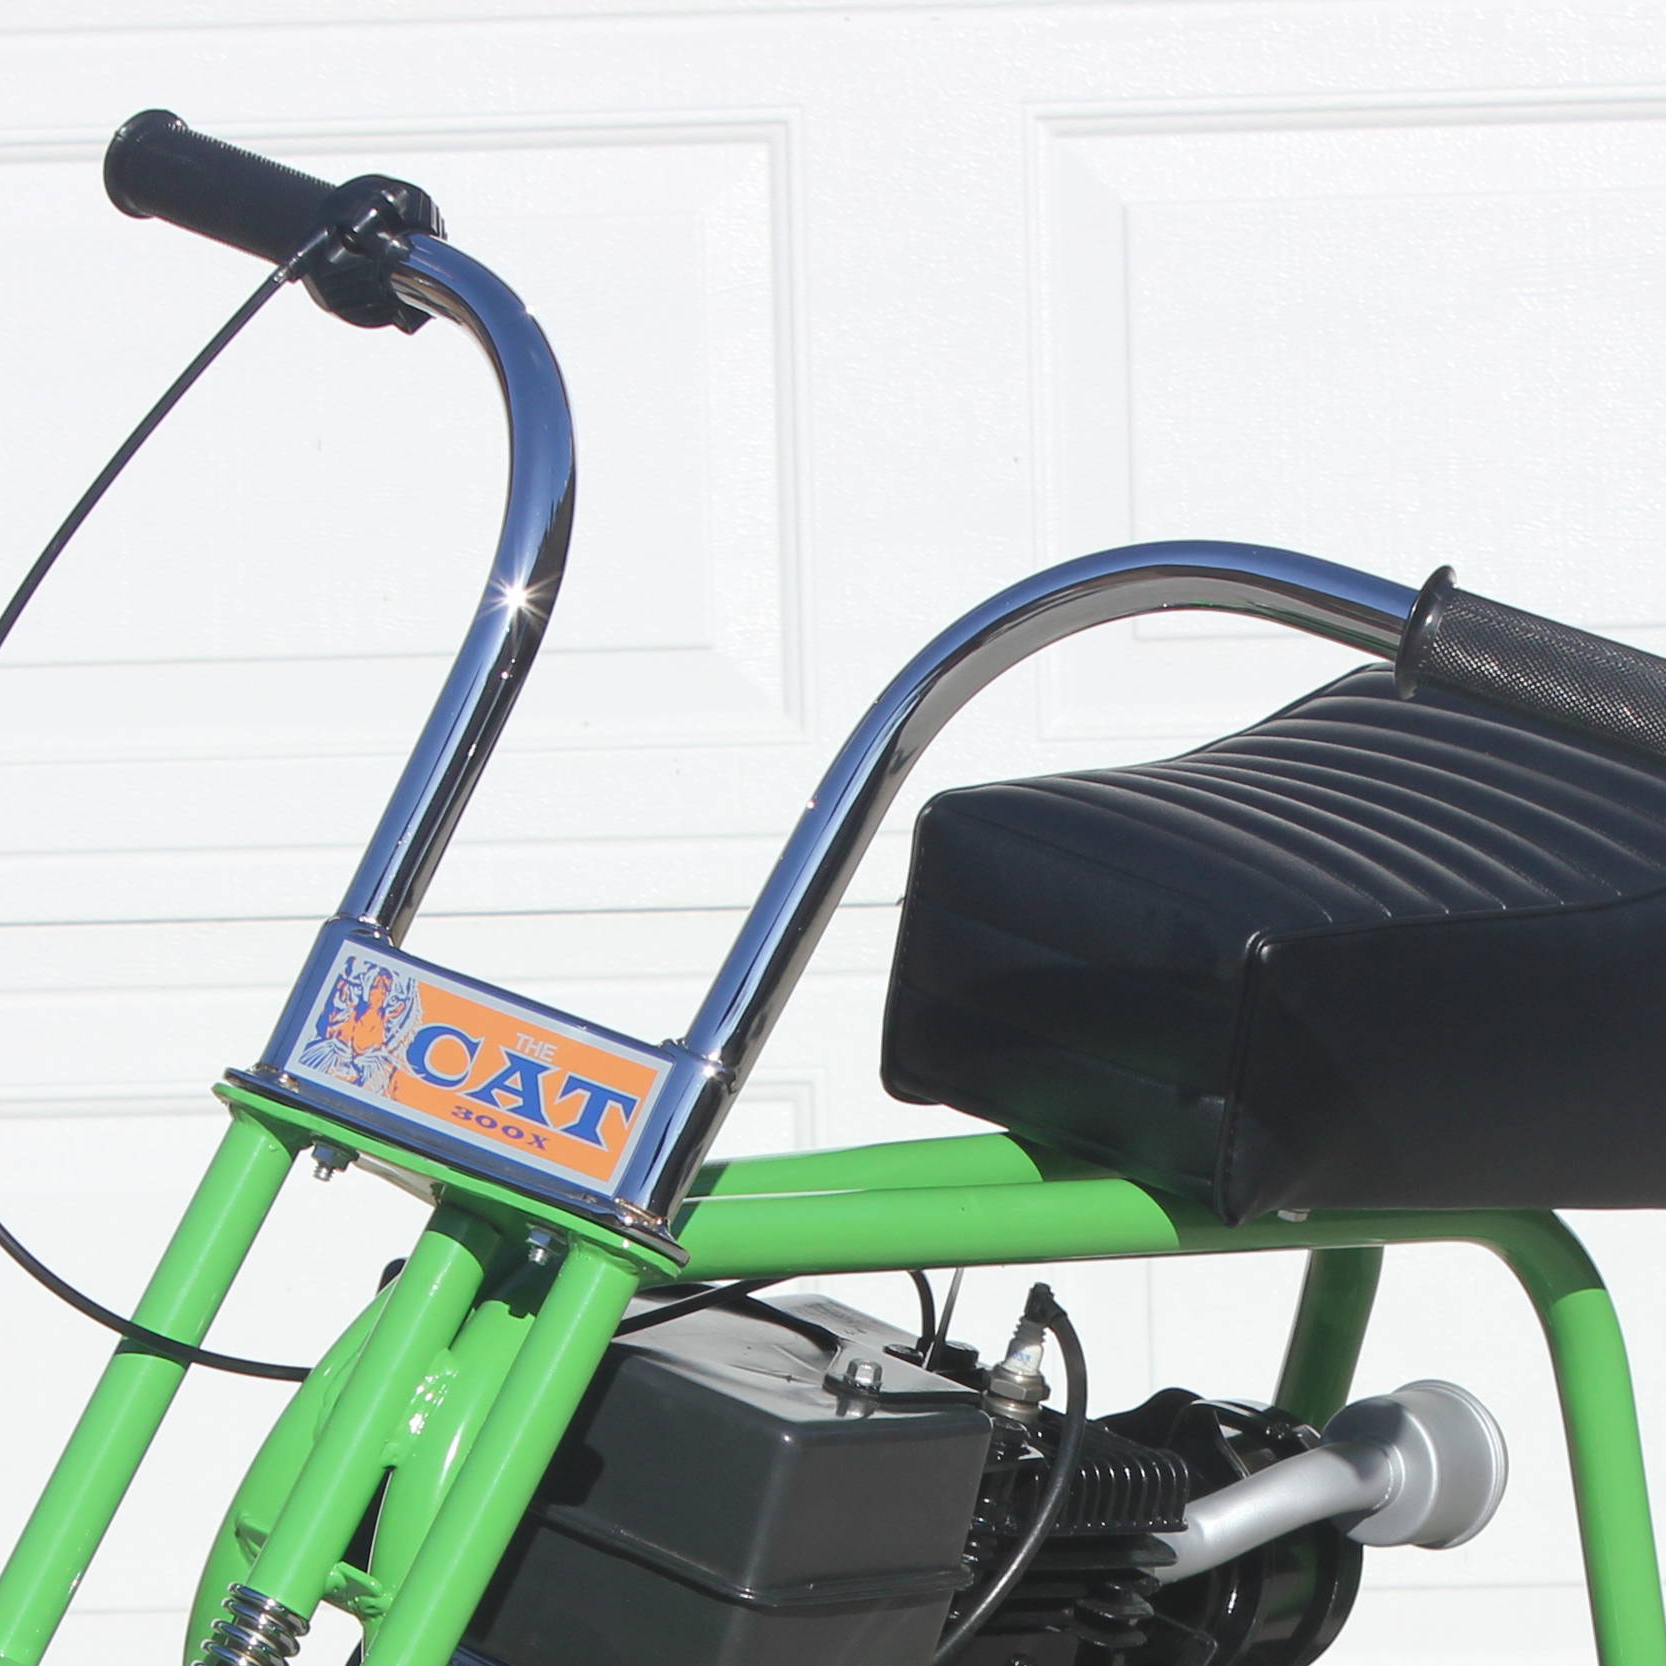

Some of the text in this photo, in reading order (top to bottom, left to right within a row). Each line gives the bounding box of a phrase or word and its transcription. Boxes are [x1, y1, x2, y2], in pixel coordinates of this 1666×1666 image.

[516, 1032, 557, 1062] THE
[405, 1022, 641, 1152] CAT
[451, 1105, 550, 1151] 300X
